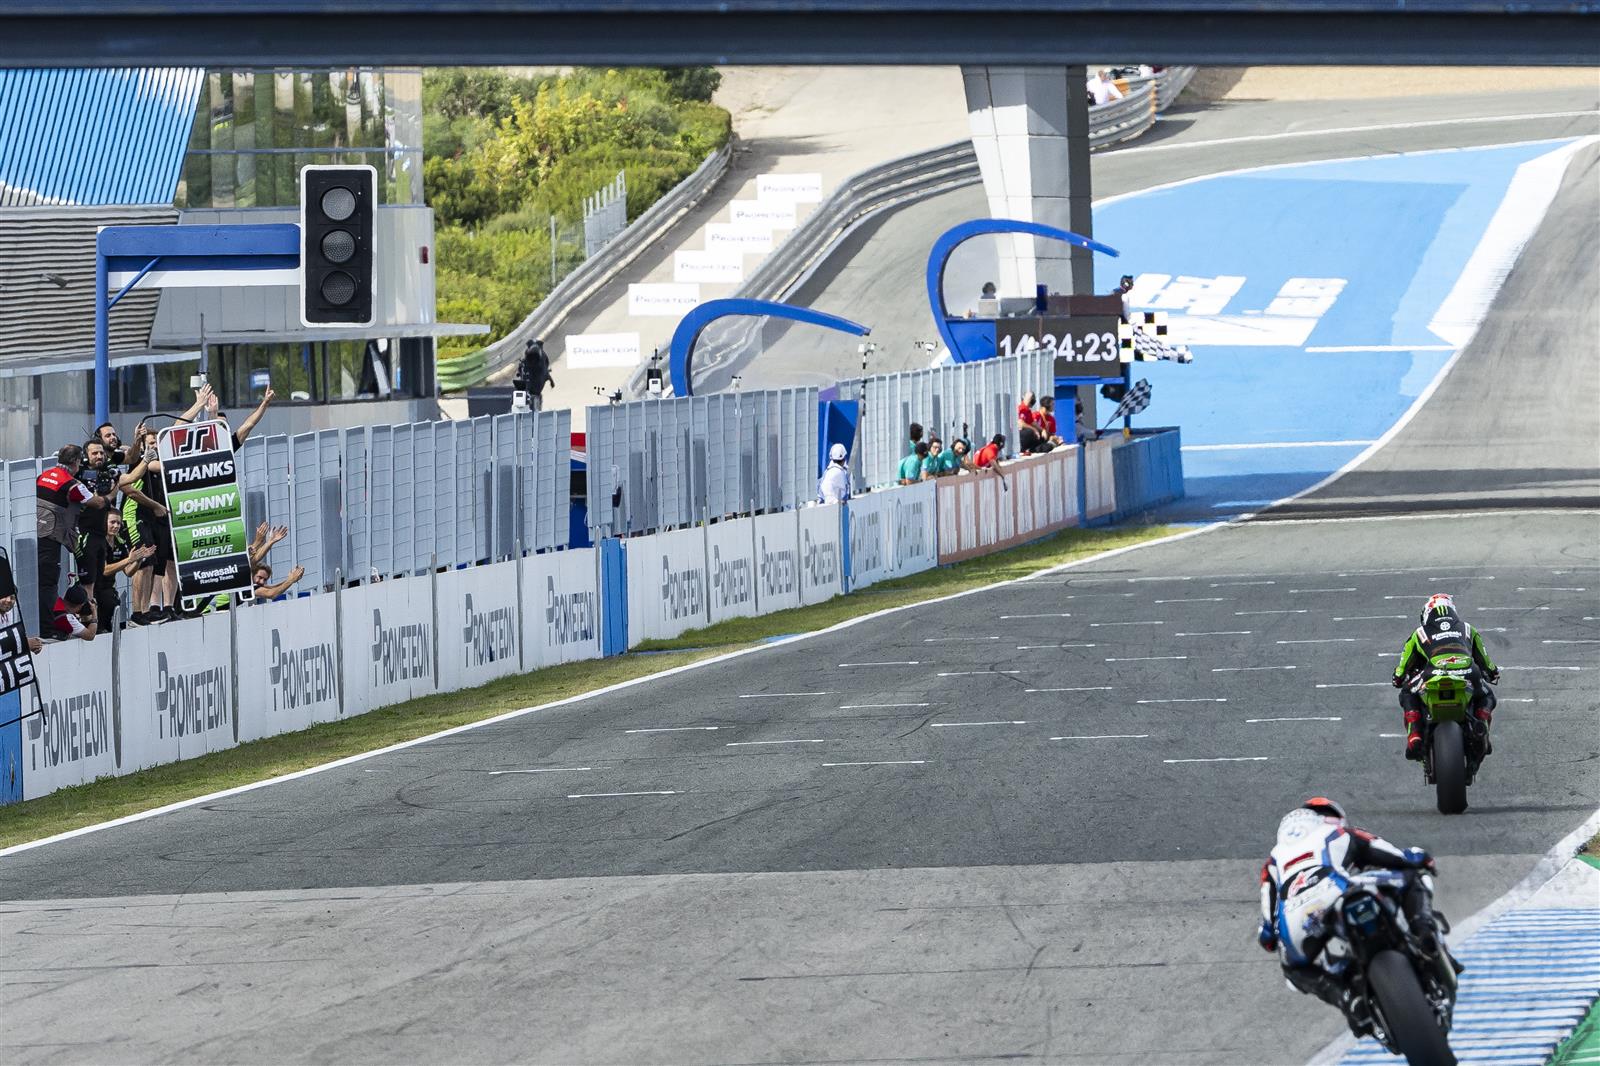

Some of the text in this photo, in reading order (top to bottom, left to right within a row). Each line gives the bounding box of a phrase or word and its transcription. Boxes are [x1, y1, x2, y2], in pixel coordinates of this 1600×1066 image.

[169, 460, 234, 484] THANKS
[175, 492, 236, 515] JOHNNY
[191, 524, 227, 537] DREAM
[191, 544, 233, 559] ACHIEVE
[192, 534, 231, 548] BELIEVE
[193, 564, 238, 580] Kawasaki
[463, 593, 515, 668] PROMETEON
[546, 575, 595, 647] PROMETEON
[269, 629, 336, 711] PROMETEON
[371, 608, 430, 687] PROMETEON
[155, 651, 227, 739] PROMETEON
[27, 676, 109, 771] PROMETEON
